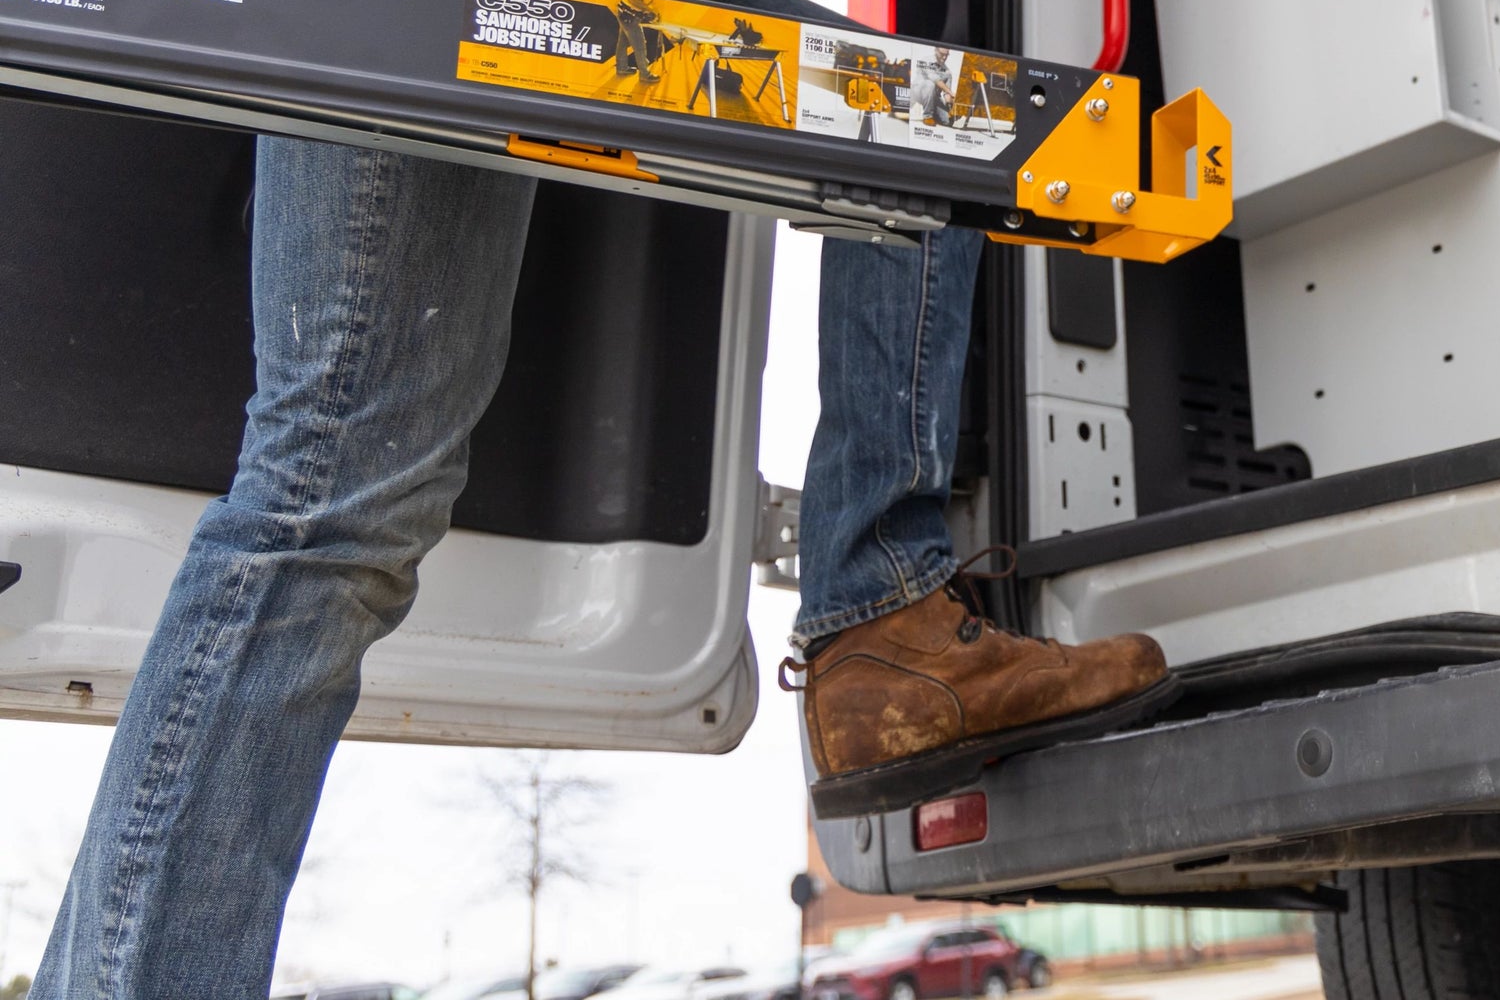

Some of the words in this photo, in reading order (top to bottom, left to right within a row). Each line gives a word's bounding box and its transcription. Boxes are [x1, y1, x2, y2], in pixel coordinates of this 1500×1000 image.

[475, 9, 573, 40] SAWHORSE
[473, 26, 547, 52] JOBSITE
[549, 37, 603, 61] TABLE
[804, 36, 824, 46] 2200
[805, 44, 824, 53] 1100
